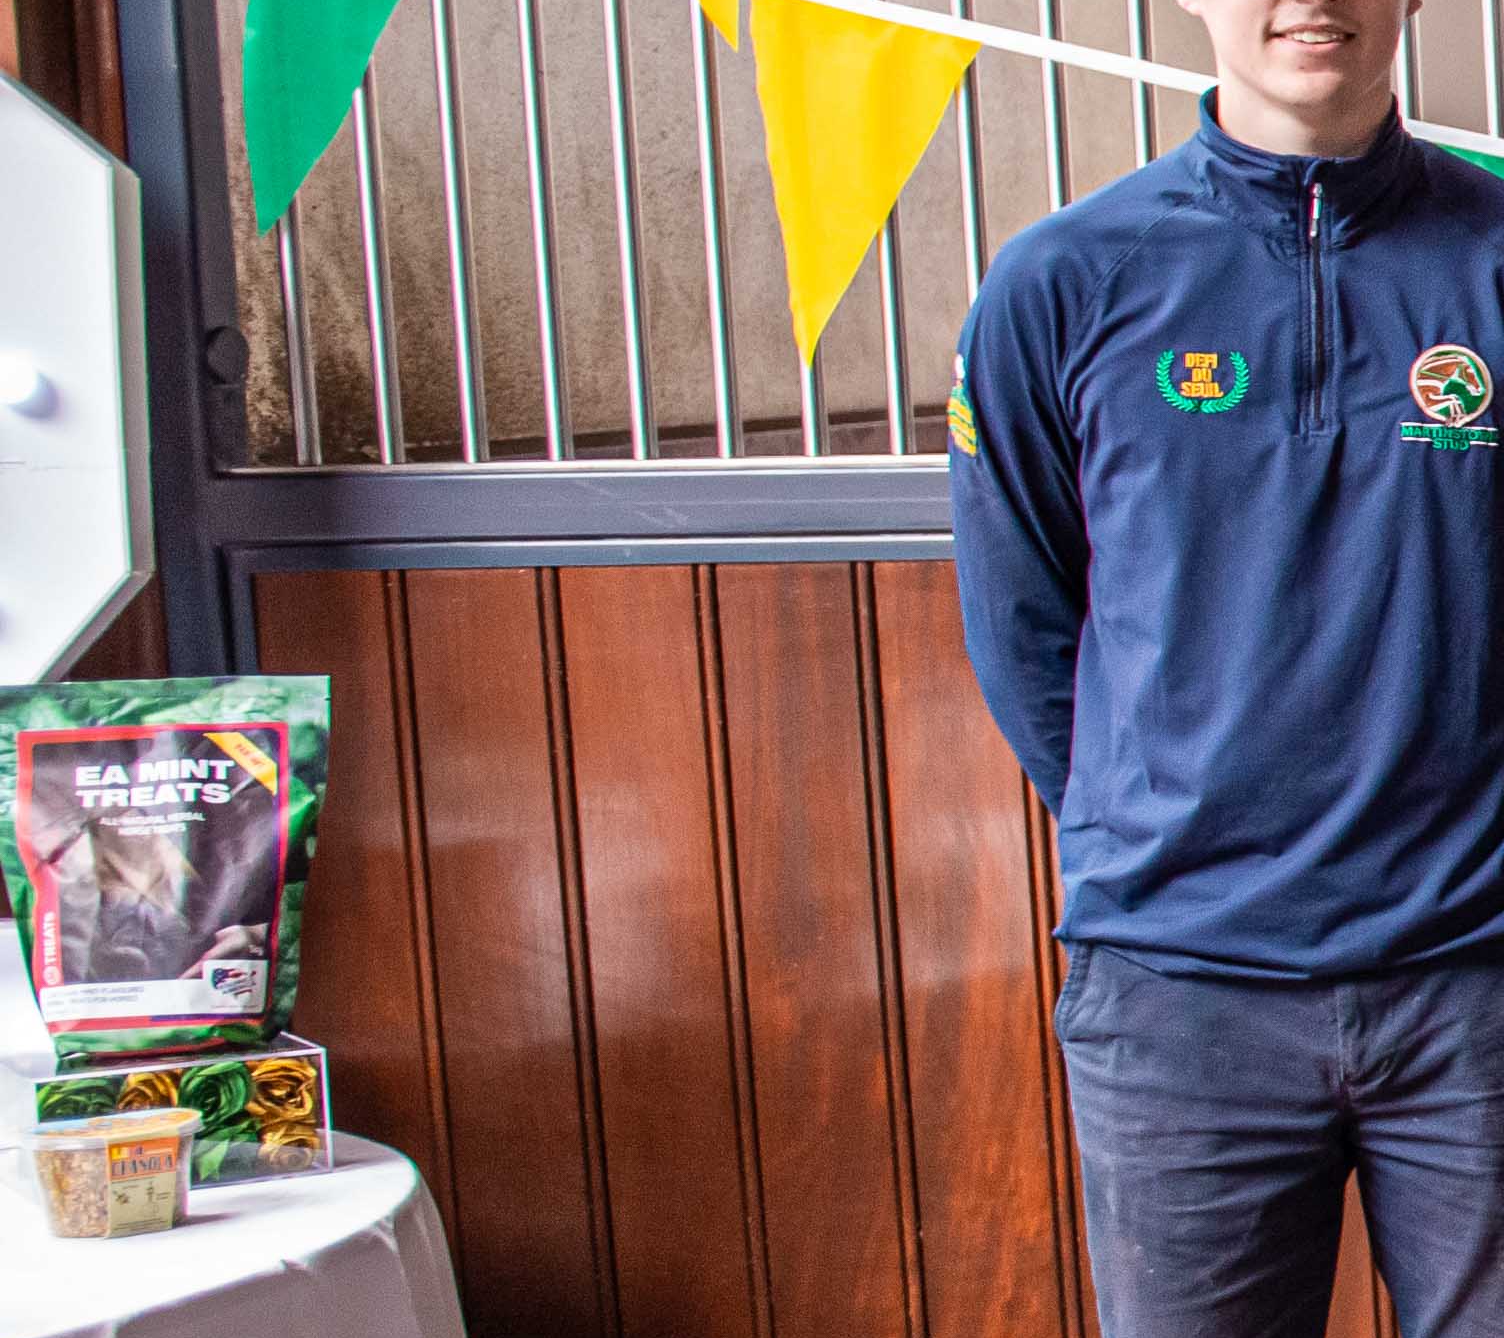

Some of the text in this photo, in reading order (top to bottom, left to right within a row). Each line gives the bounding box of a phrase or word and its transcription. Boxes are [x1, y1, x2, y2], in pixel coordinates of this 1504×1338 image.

[1192, 368, 1211, 382] DU
[1180, 382, 1224, 398] SEUIL
[1432, 439, 1470, 451] STUD
[137, 759, 234, 783] MINT
[75, 783, 231, 808] TREATS
